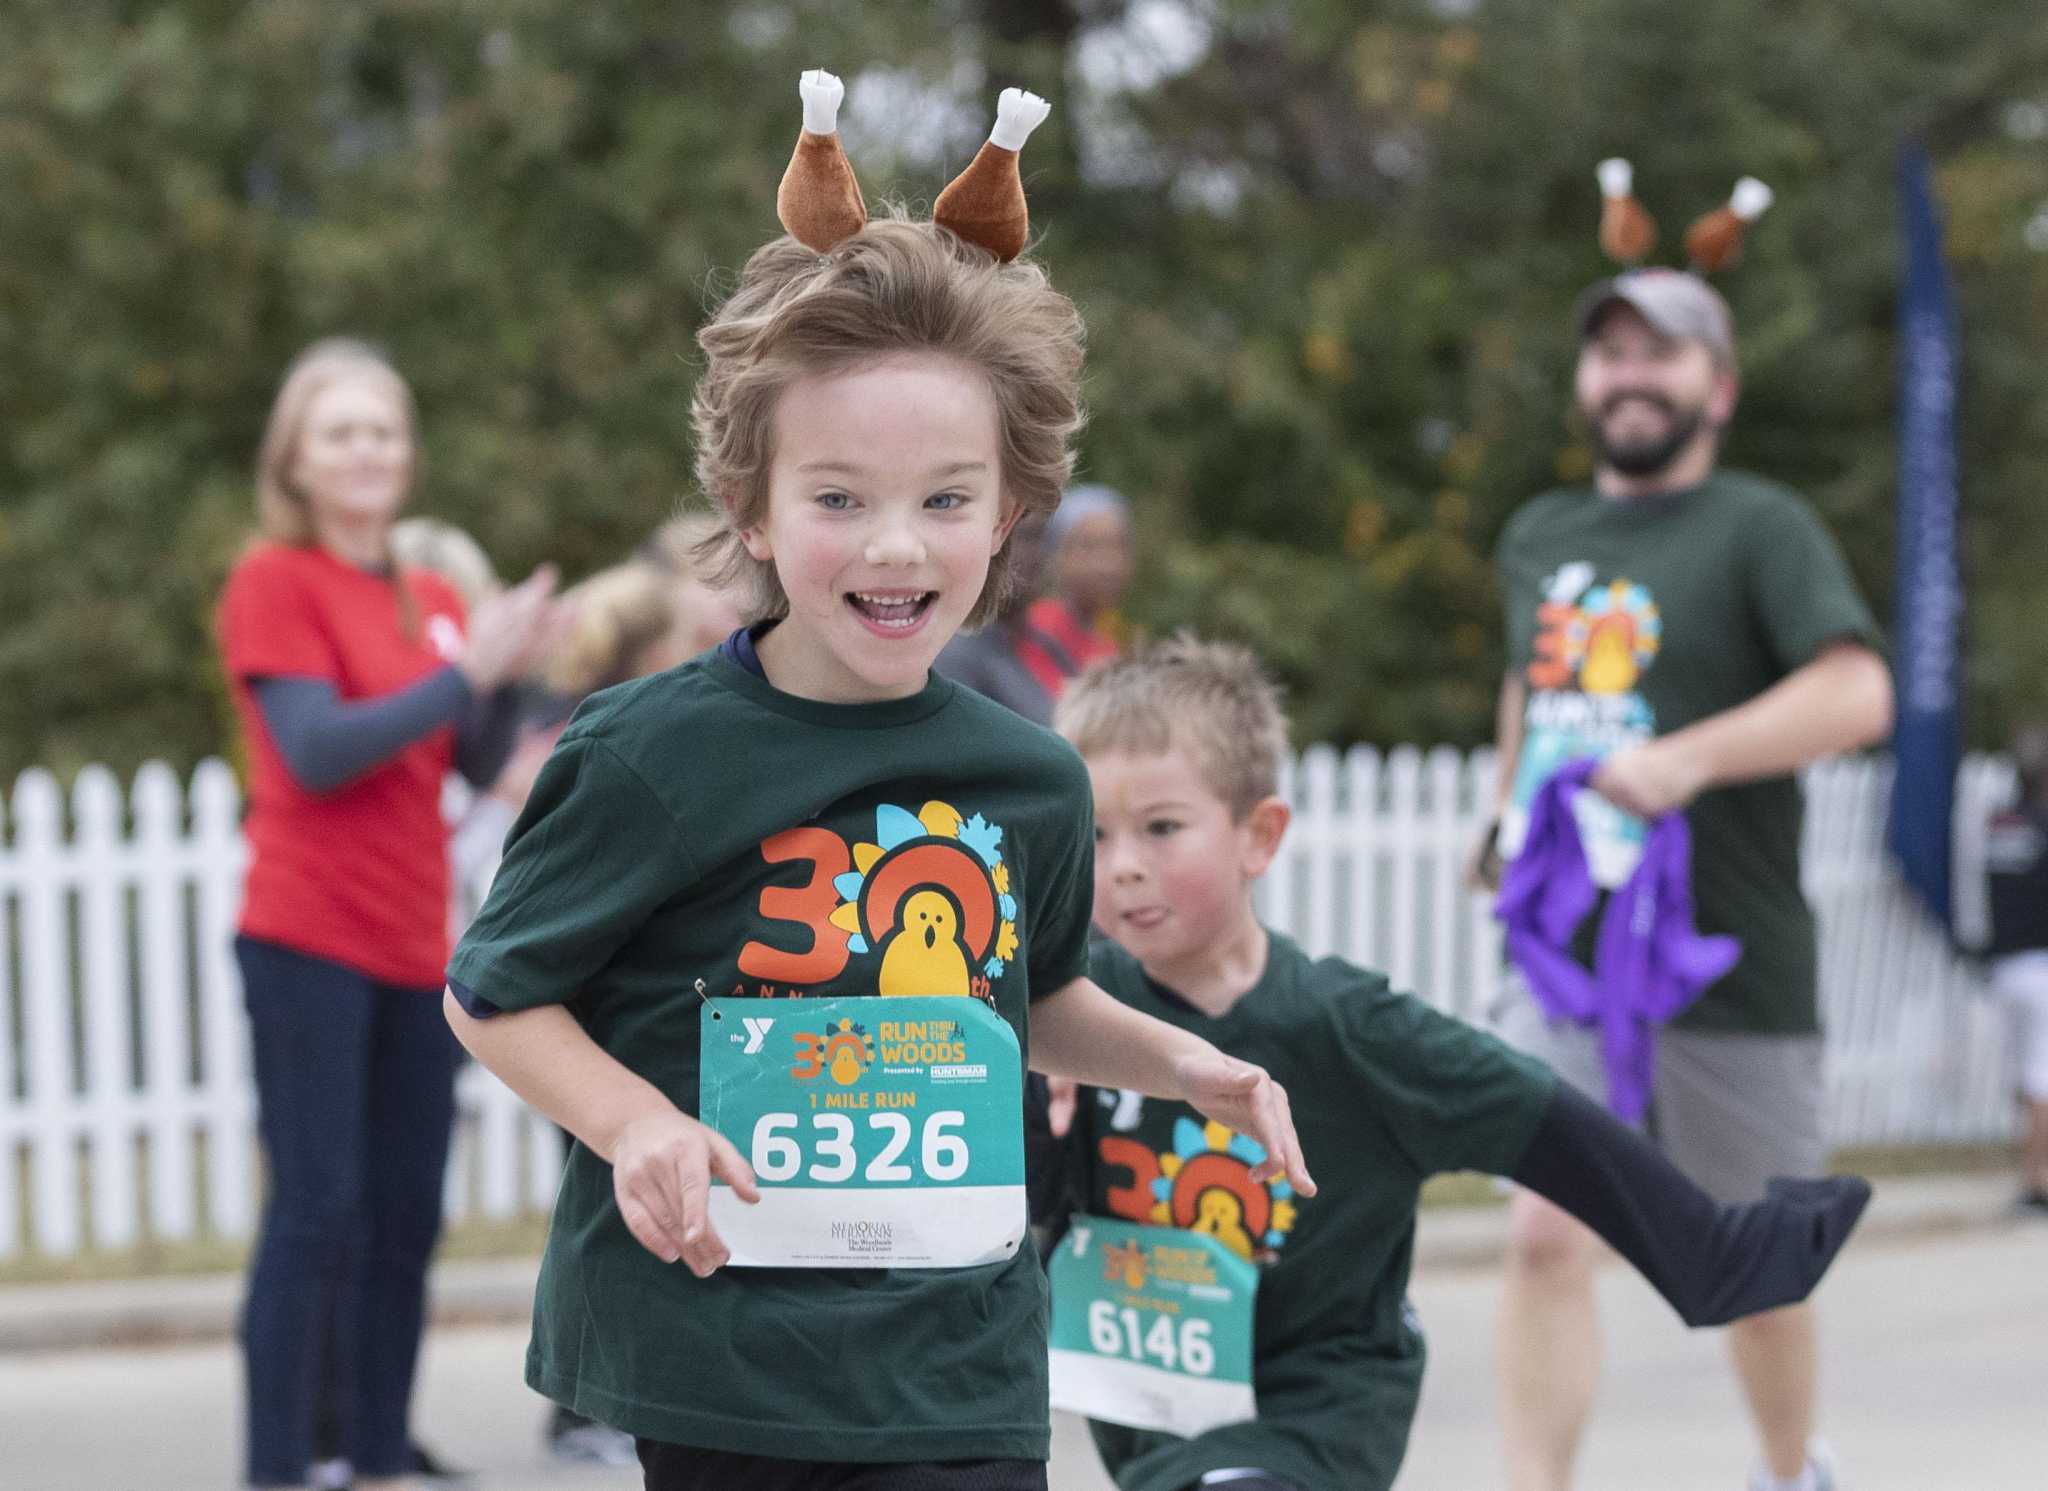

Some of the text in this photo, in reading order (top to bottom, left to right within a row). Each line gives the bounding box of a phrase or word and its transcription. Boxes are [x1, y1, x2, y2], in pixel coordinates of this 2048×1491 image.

[730, 1018, 776, 1054] the Y
[880, 1022, 927, 1041] RUN
[880, 1042, 966, 1064] WOODS
[810, 1091, 917, 1109] 1 MILE RUN
[751, 1110, 970, 1183] 6326
[1087, 1299, 1216, 1376] 6146
